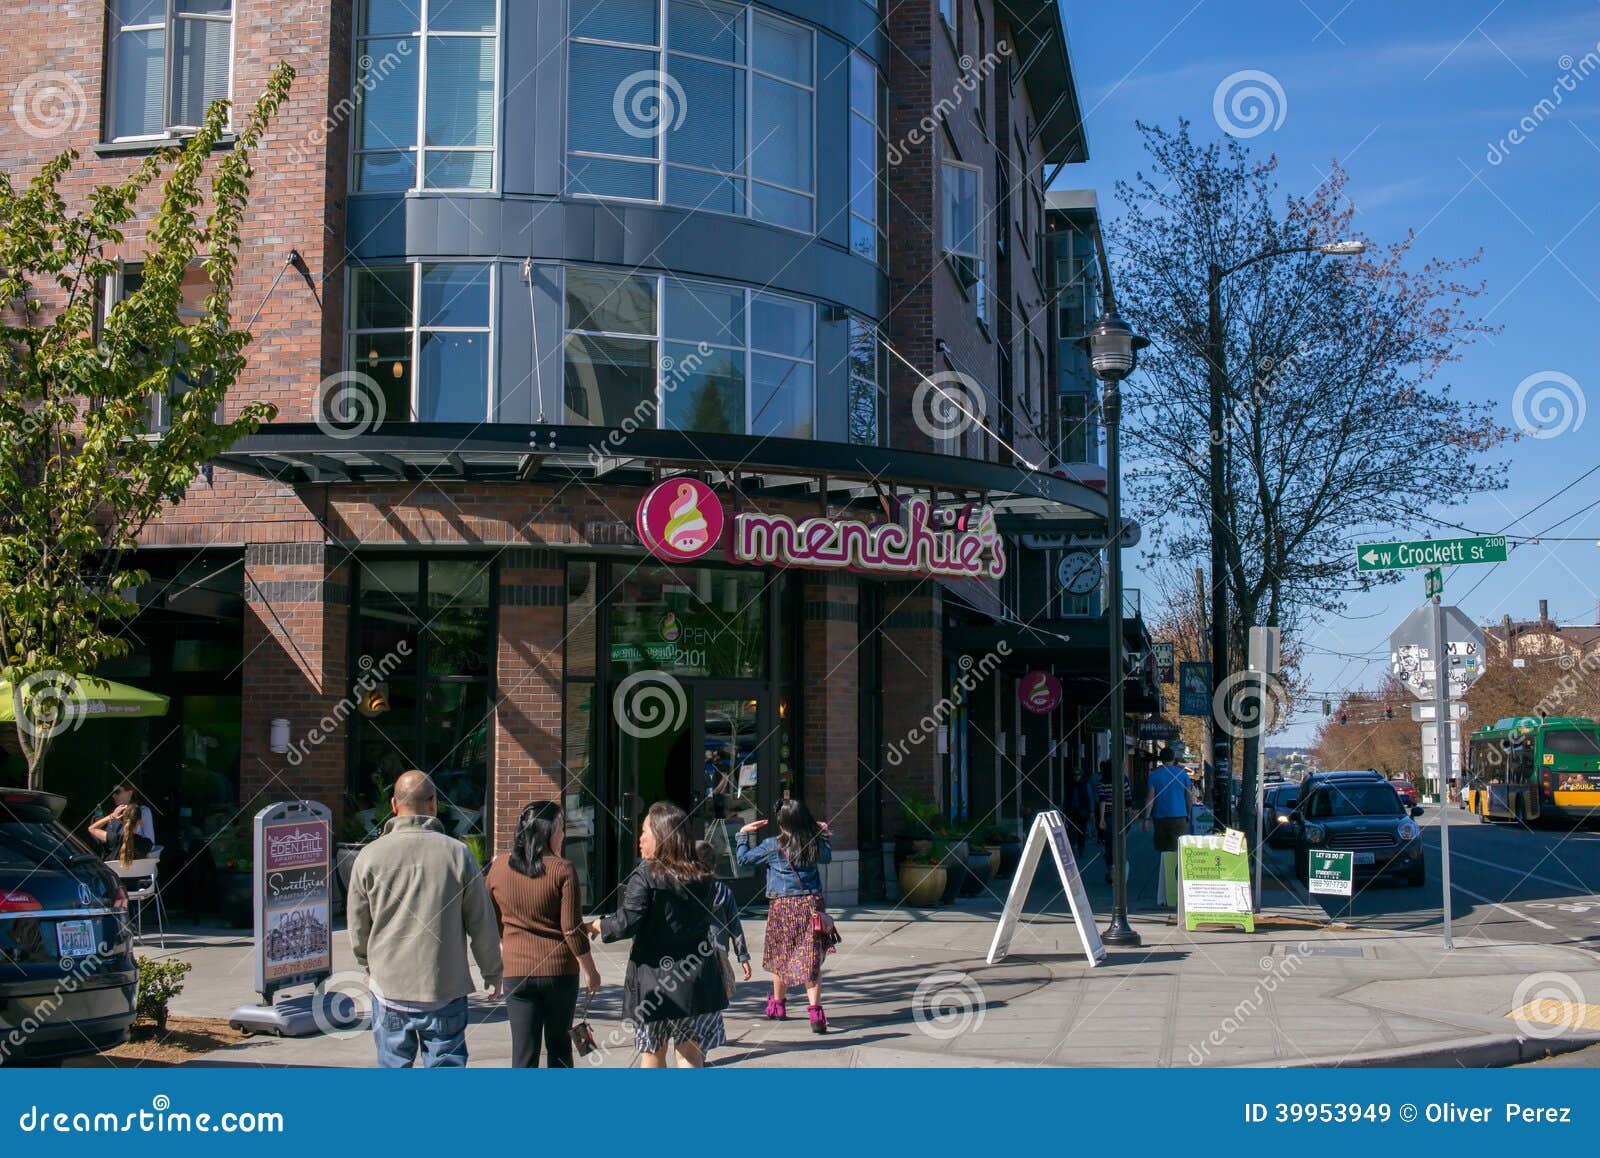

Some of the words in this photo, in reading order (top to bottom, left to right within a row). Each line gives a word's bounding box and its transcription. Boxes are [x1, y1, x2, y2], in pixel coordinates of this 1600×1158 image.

[737, 495, 1006, 579] menchie's
[1380, 551, 1391, 565] W
[1398, 542, 1464, 564] Crockett
[1471, 546, 1485, 559] St
[1485, 538, 1505, 548] 2100
[674, 650, 706, 666] 2101
[271, 842, 300, 854] EDEN
[301, 838, 323, 851] HILL
